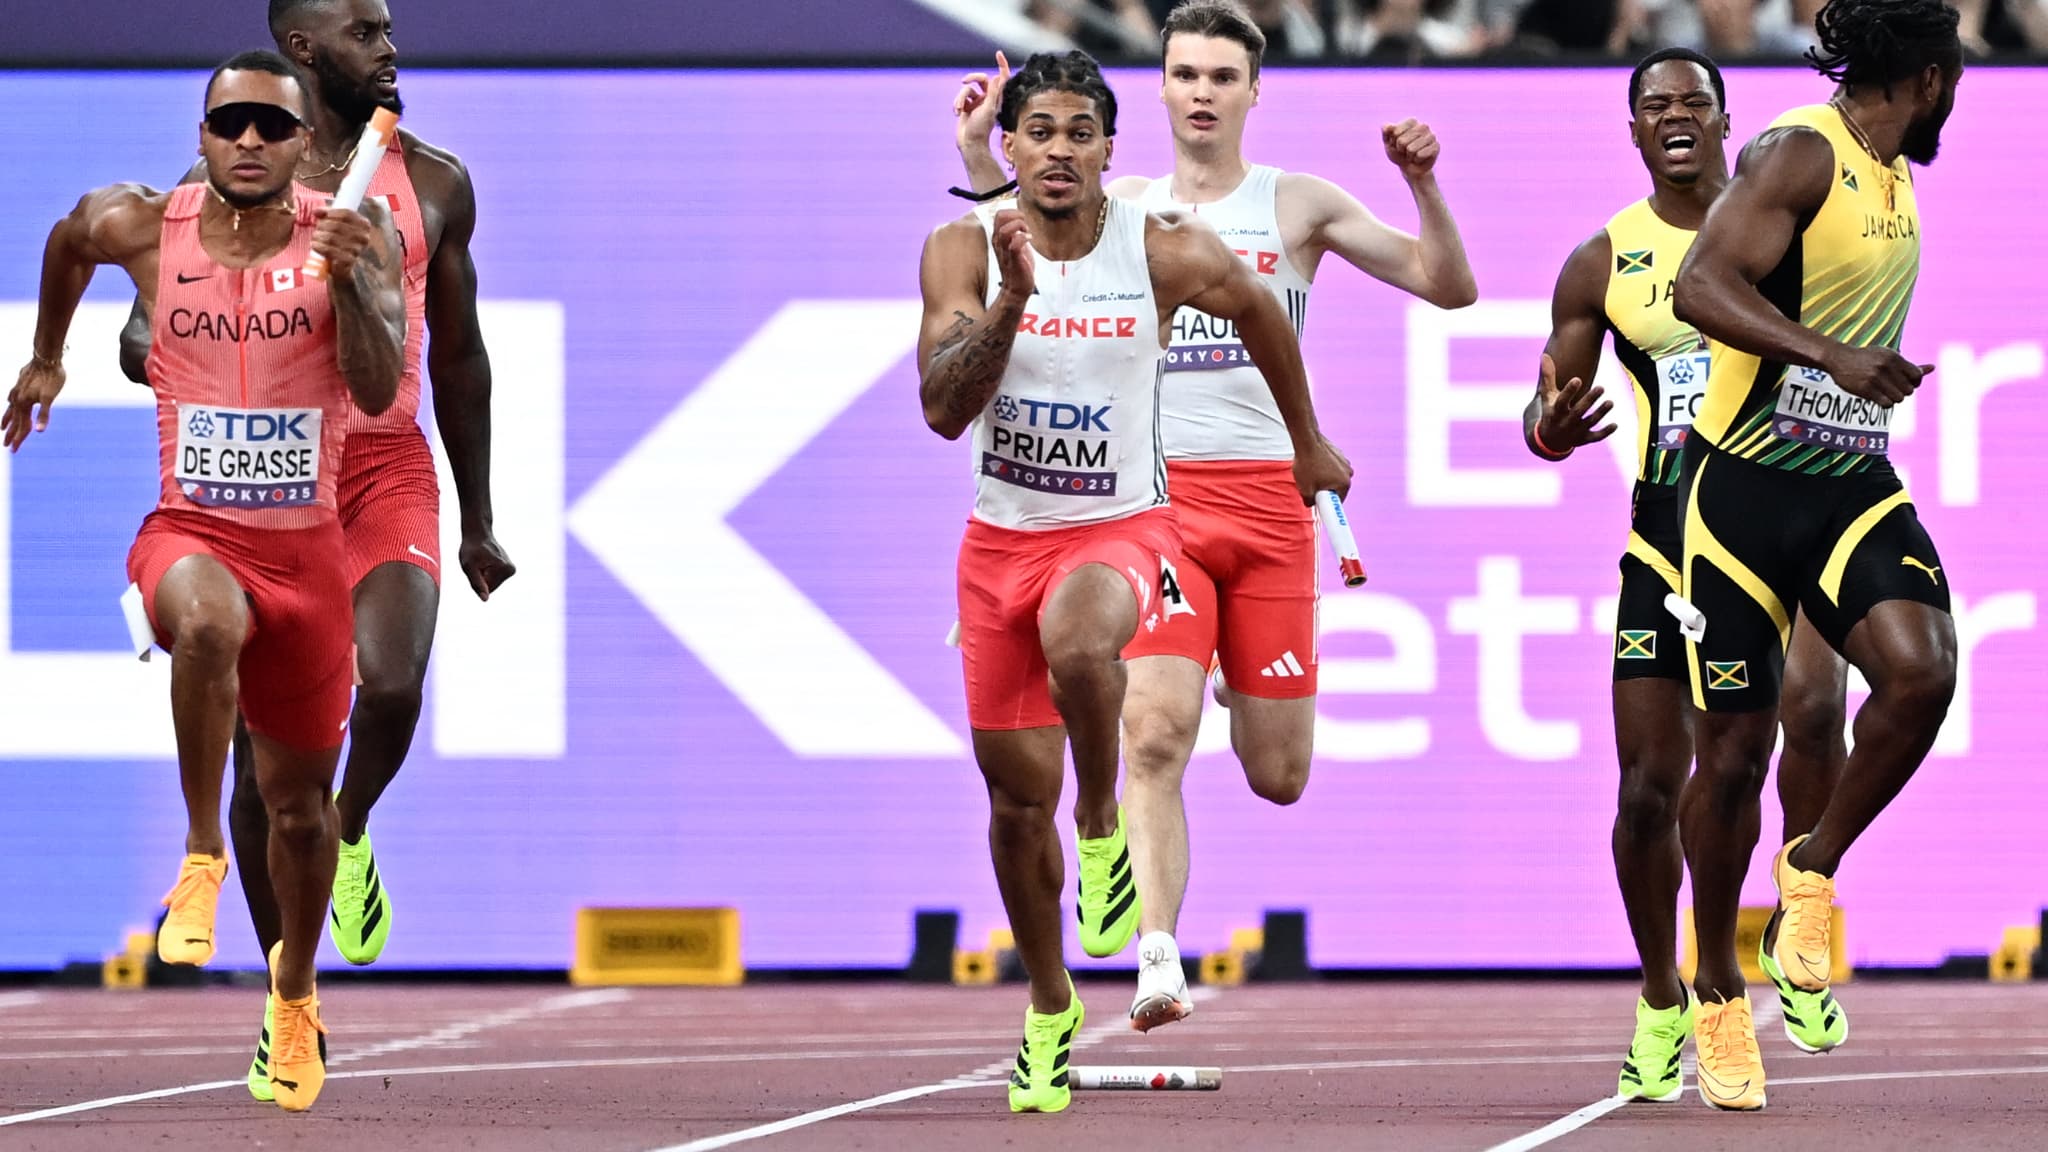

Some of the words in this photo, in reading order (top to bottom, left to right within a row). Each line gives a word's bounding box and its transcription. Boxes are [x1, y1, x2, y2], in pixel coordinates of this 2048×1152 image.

[170, 307, 313, 342] CANADA
[1017, 312, 1137, 338] RANCE
[1166, 349, 1251, 363] OKYO25
[1019, 398, 1112, 432] TDK
[1789, 384, 1894, 426] THOMPSON
[215, 412, 309, 441] TDK
[184, 445, 212, 477] DE
[219, 448, 312, 479] GRASSE
[993, 425, 1108, 468] PRIAM
